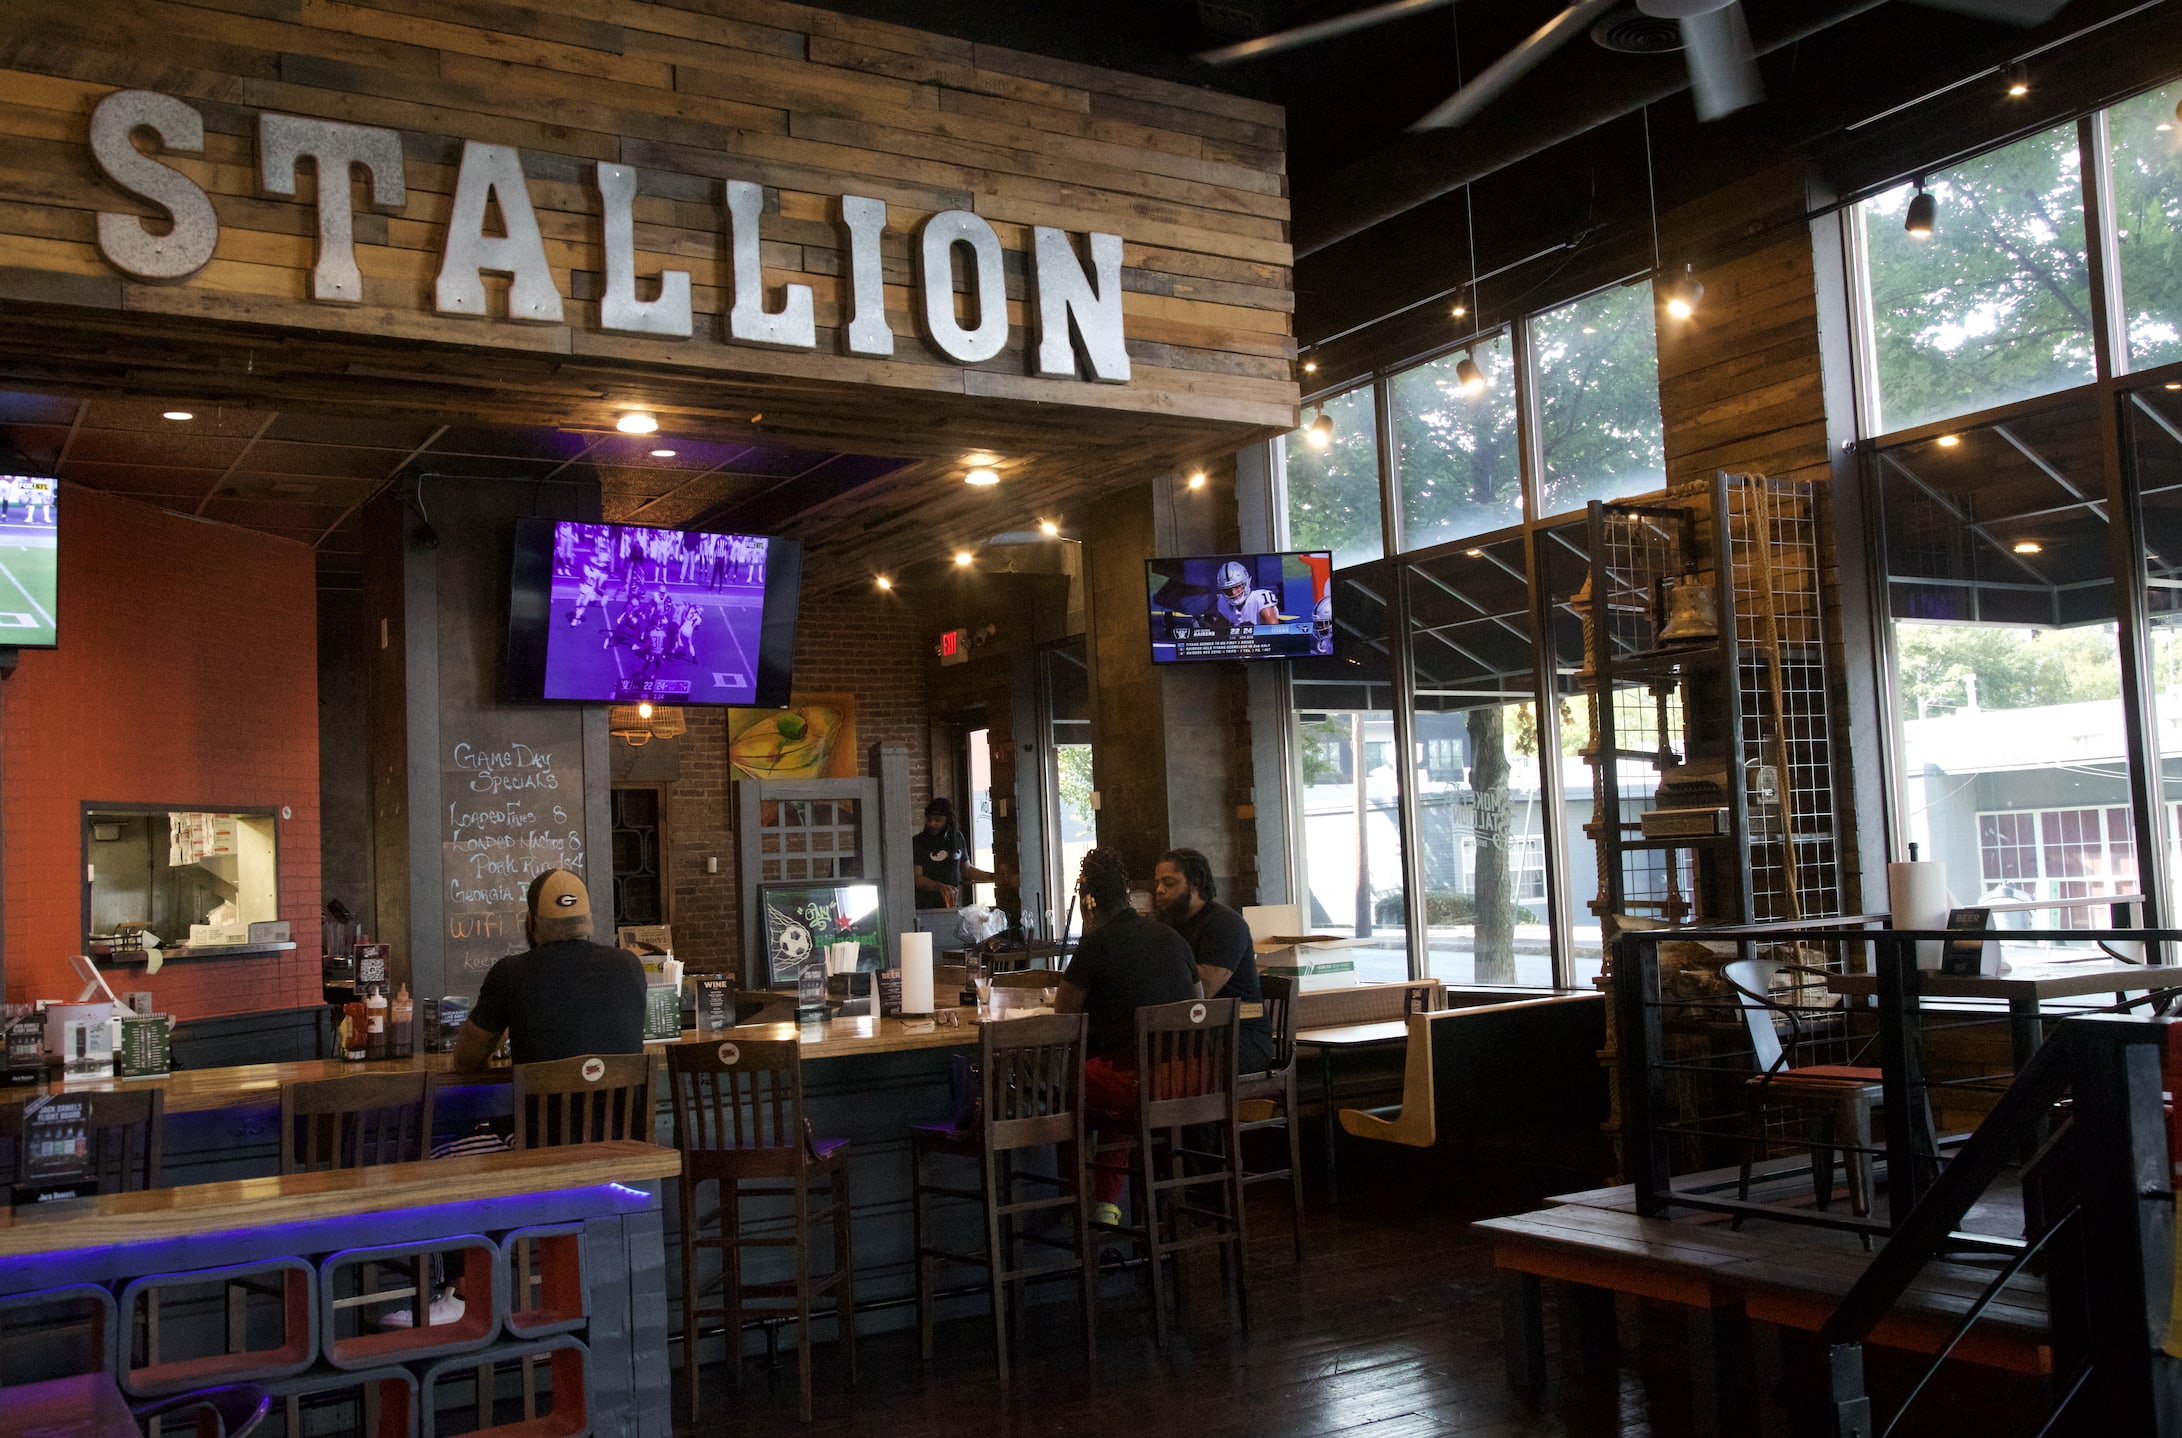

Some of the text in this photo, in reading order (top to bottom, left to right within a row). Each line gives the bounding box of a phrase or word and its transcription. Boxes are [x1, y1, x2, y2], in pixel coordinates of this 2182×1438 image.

[89, 89, 1131, 385] STALLION
[943, 631, 957, 657] EXIT
[643, 681, 653, 690] 22
[656, 682, 665, 690] 24
[553, 805, 568, 824] 8
[568, 830, 581, 850] 8
[1956, 913, 1980, 923] BEER
[881, 971, 901, 979] BEER
[703, 981, 728, 989] WINE
